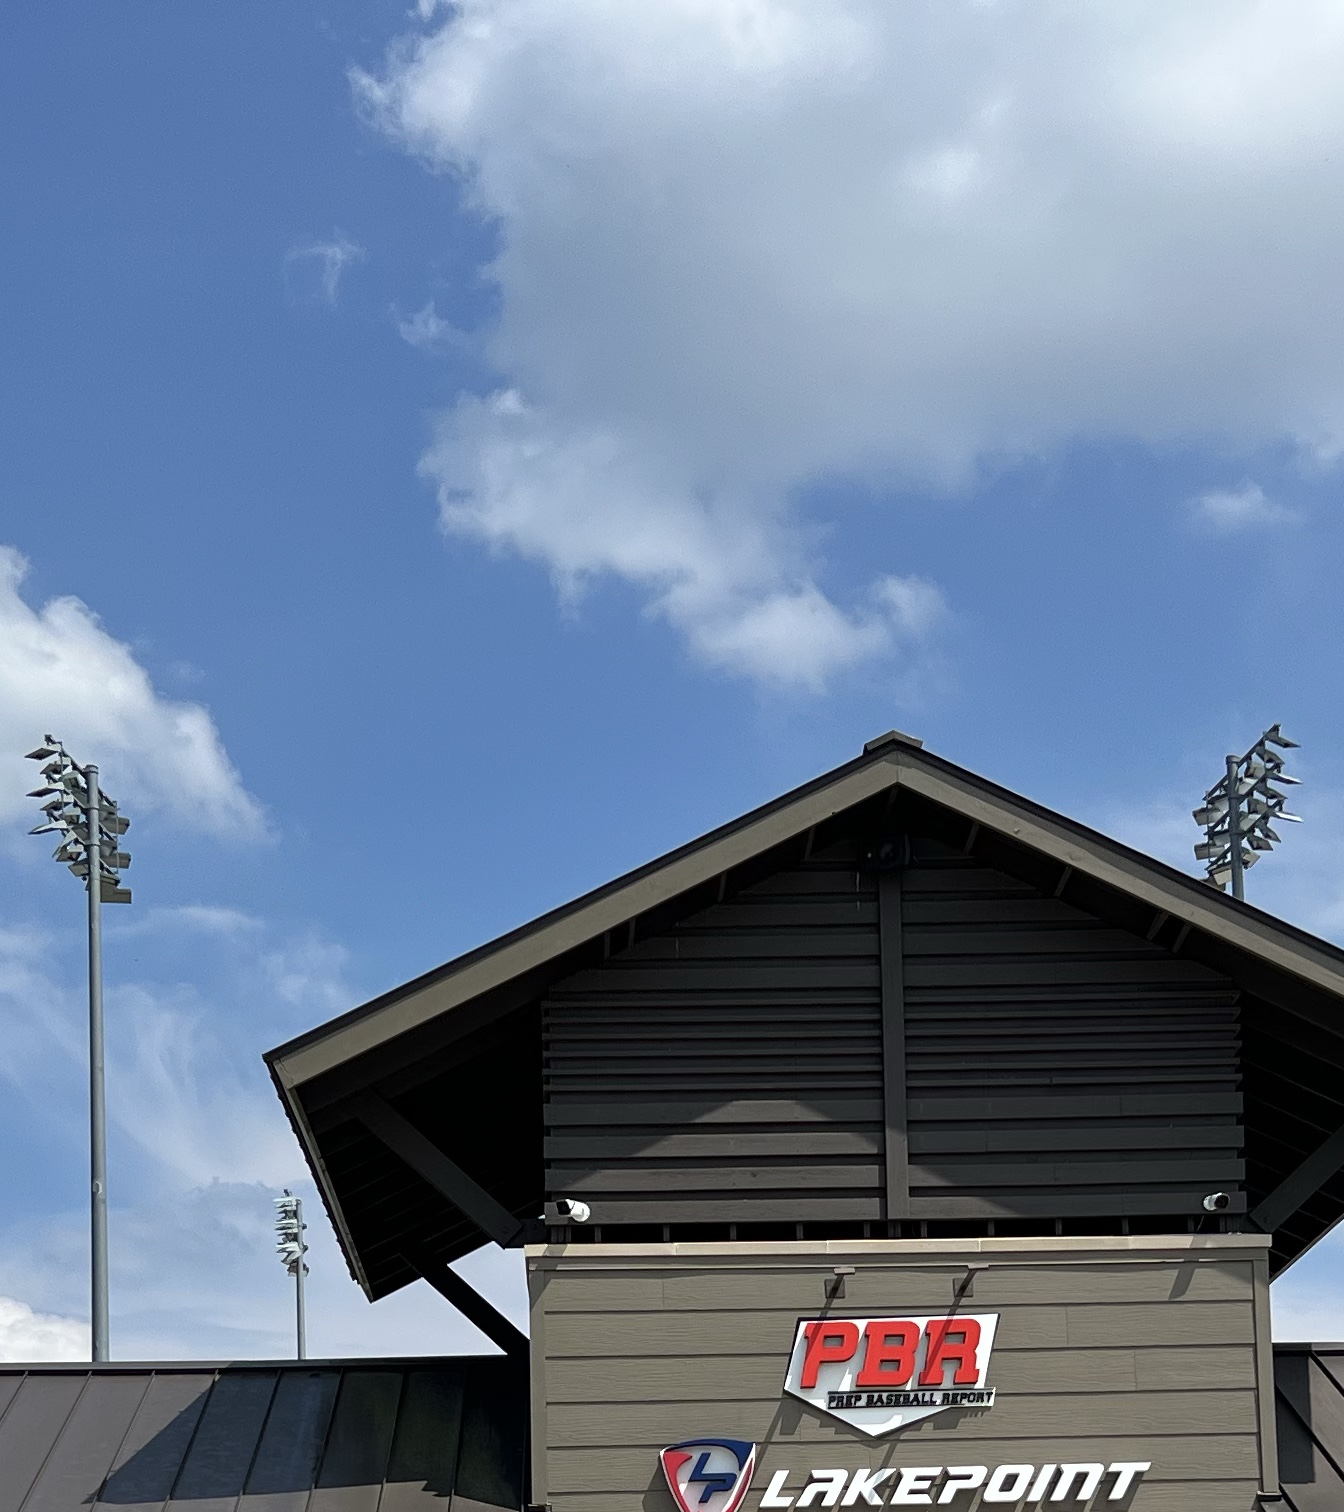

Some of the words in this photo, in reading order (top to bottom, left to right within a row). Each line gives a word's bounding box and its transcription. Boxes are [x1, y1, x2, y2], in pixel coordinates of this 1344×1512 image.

[800, 1318, 982, 1389] PBR
[828, 1395, 862, 1408] PREP
[866, 1393, 937, 1406] BASEBALL
[941, 1391, 993, 1405] REPORT
[759, 1461, 1152, 1508] LAKEPOINT
